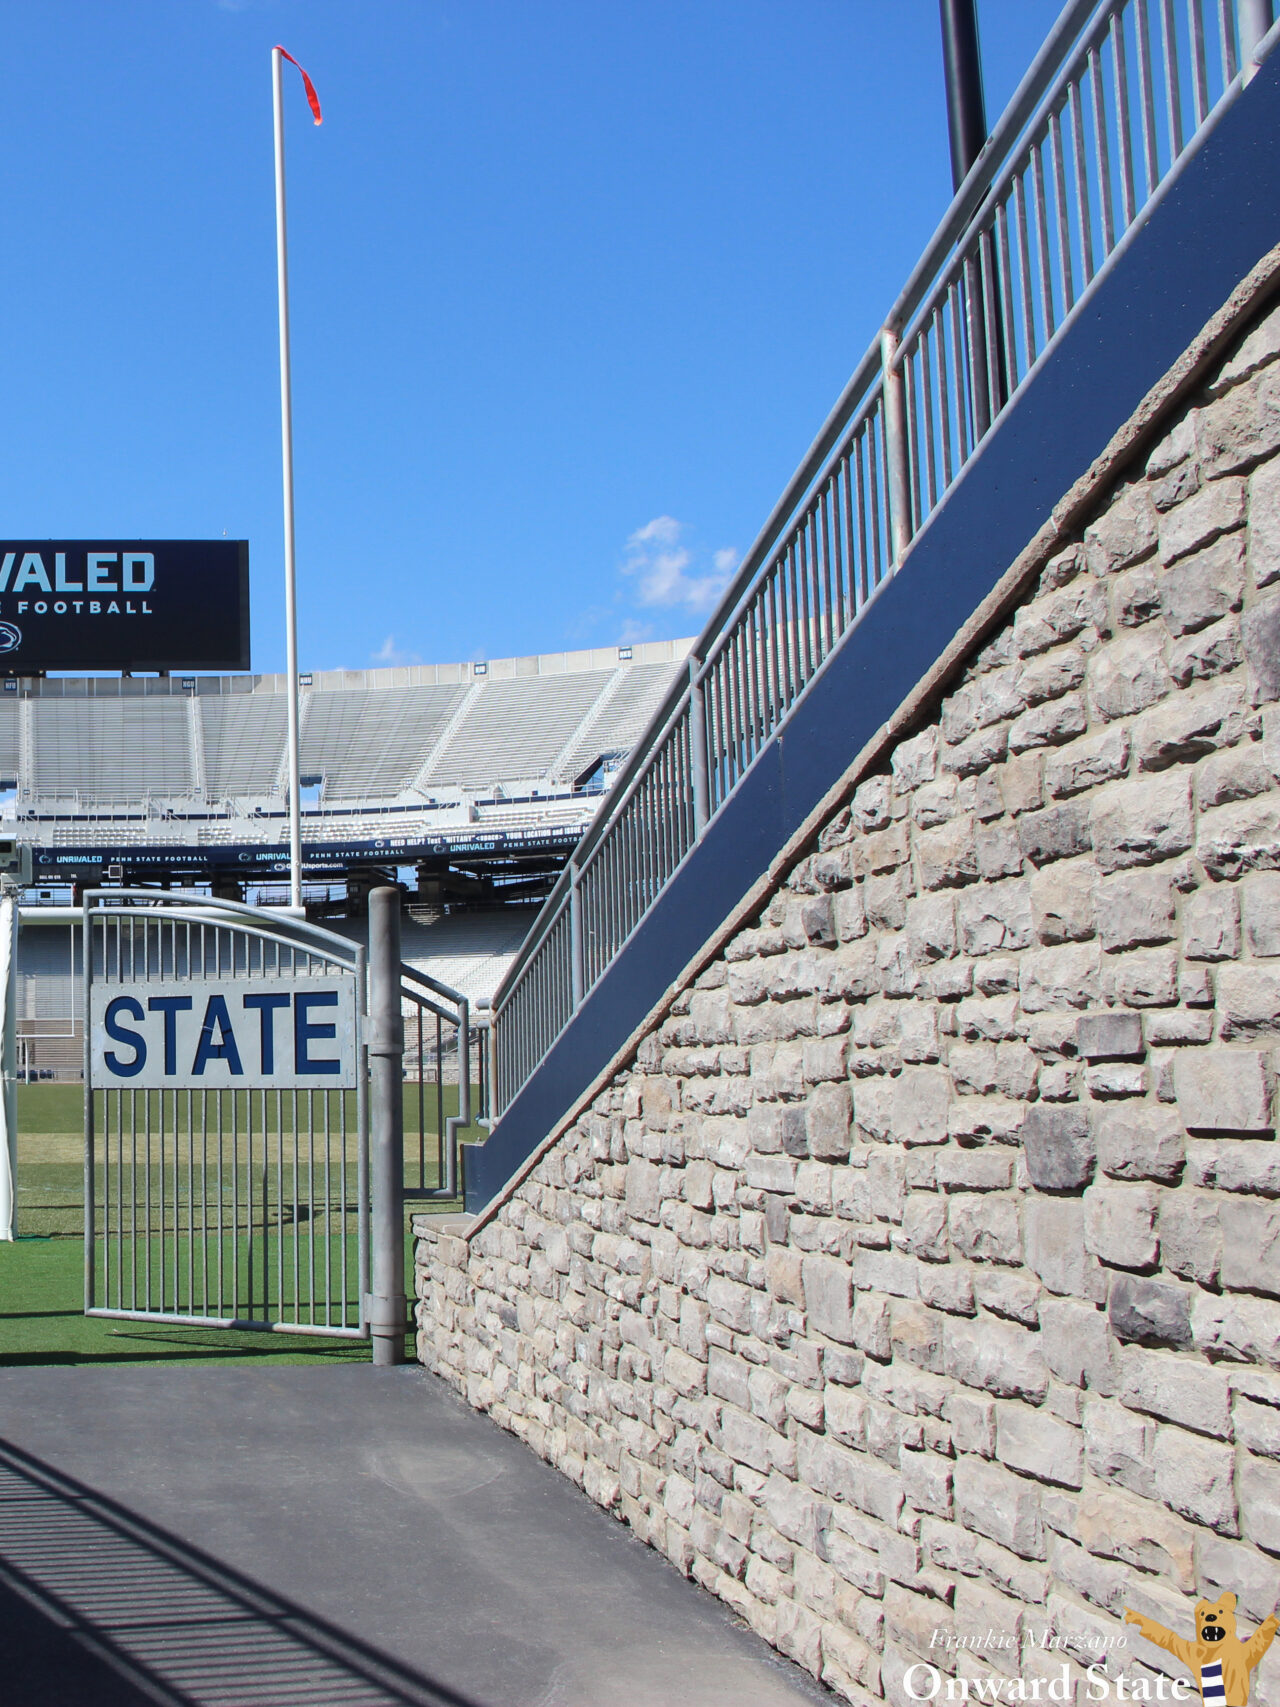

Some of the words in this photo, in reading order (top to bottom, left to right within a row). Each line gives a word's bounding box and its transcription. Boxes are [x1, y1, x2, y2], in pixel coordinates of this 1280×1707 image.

[17, 600, 153, 614] FOOTBALL
[450, 842, 495, 852] UNRIVALED
[527, 839, 550, 847] STATE
[553, 836, 582, 844] FOOTBA
[56, 855, 103, 863] UNRIVALED
[256, 852, 292, 861] UNRIVAL
[363, 849, 405, 857] FOOTBALL
[104, 990, 341, 1078] STATE
